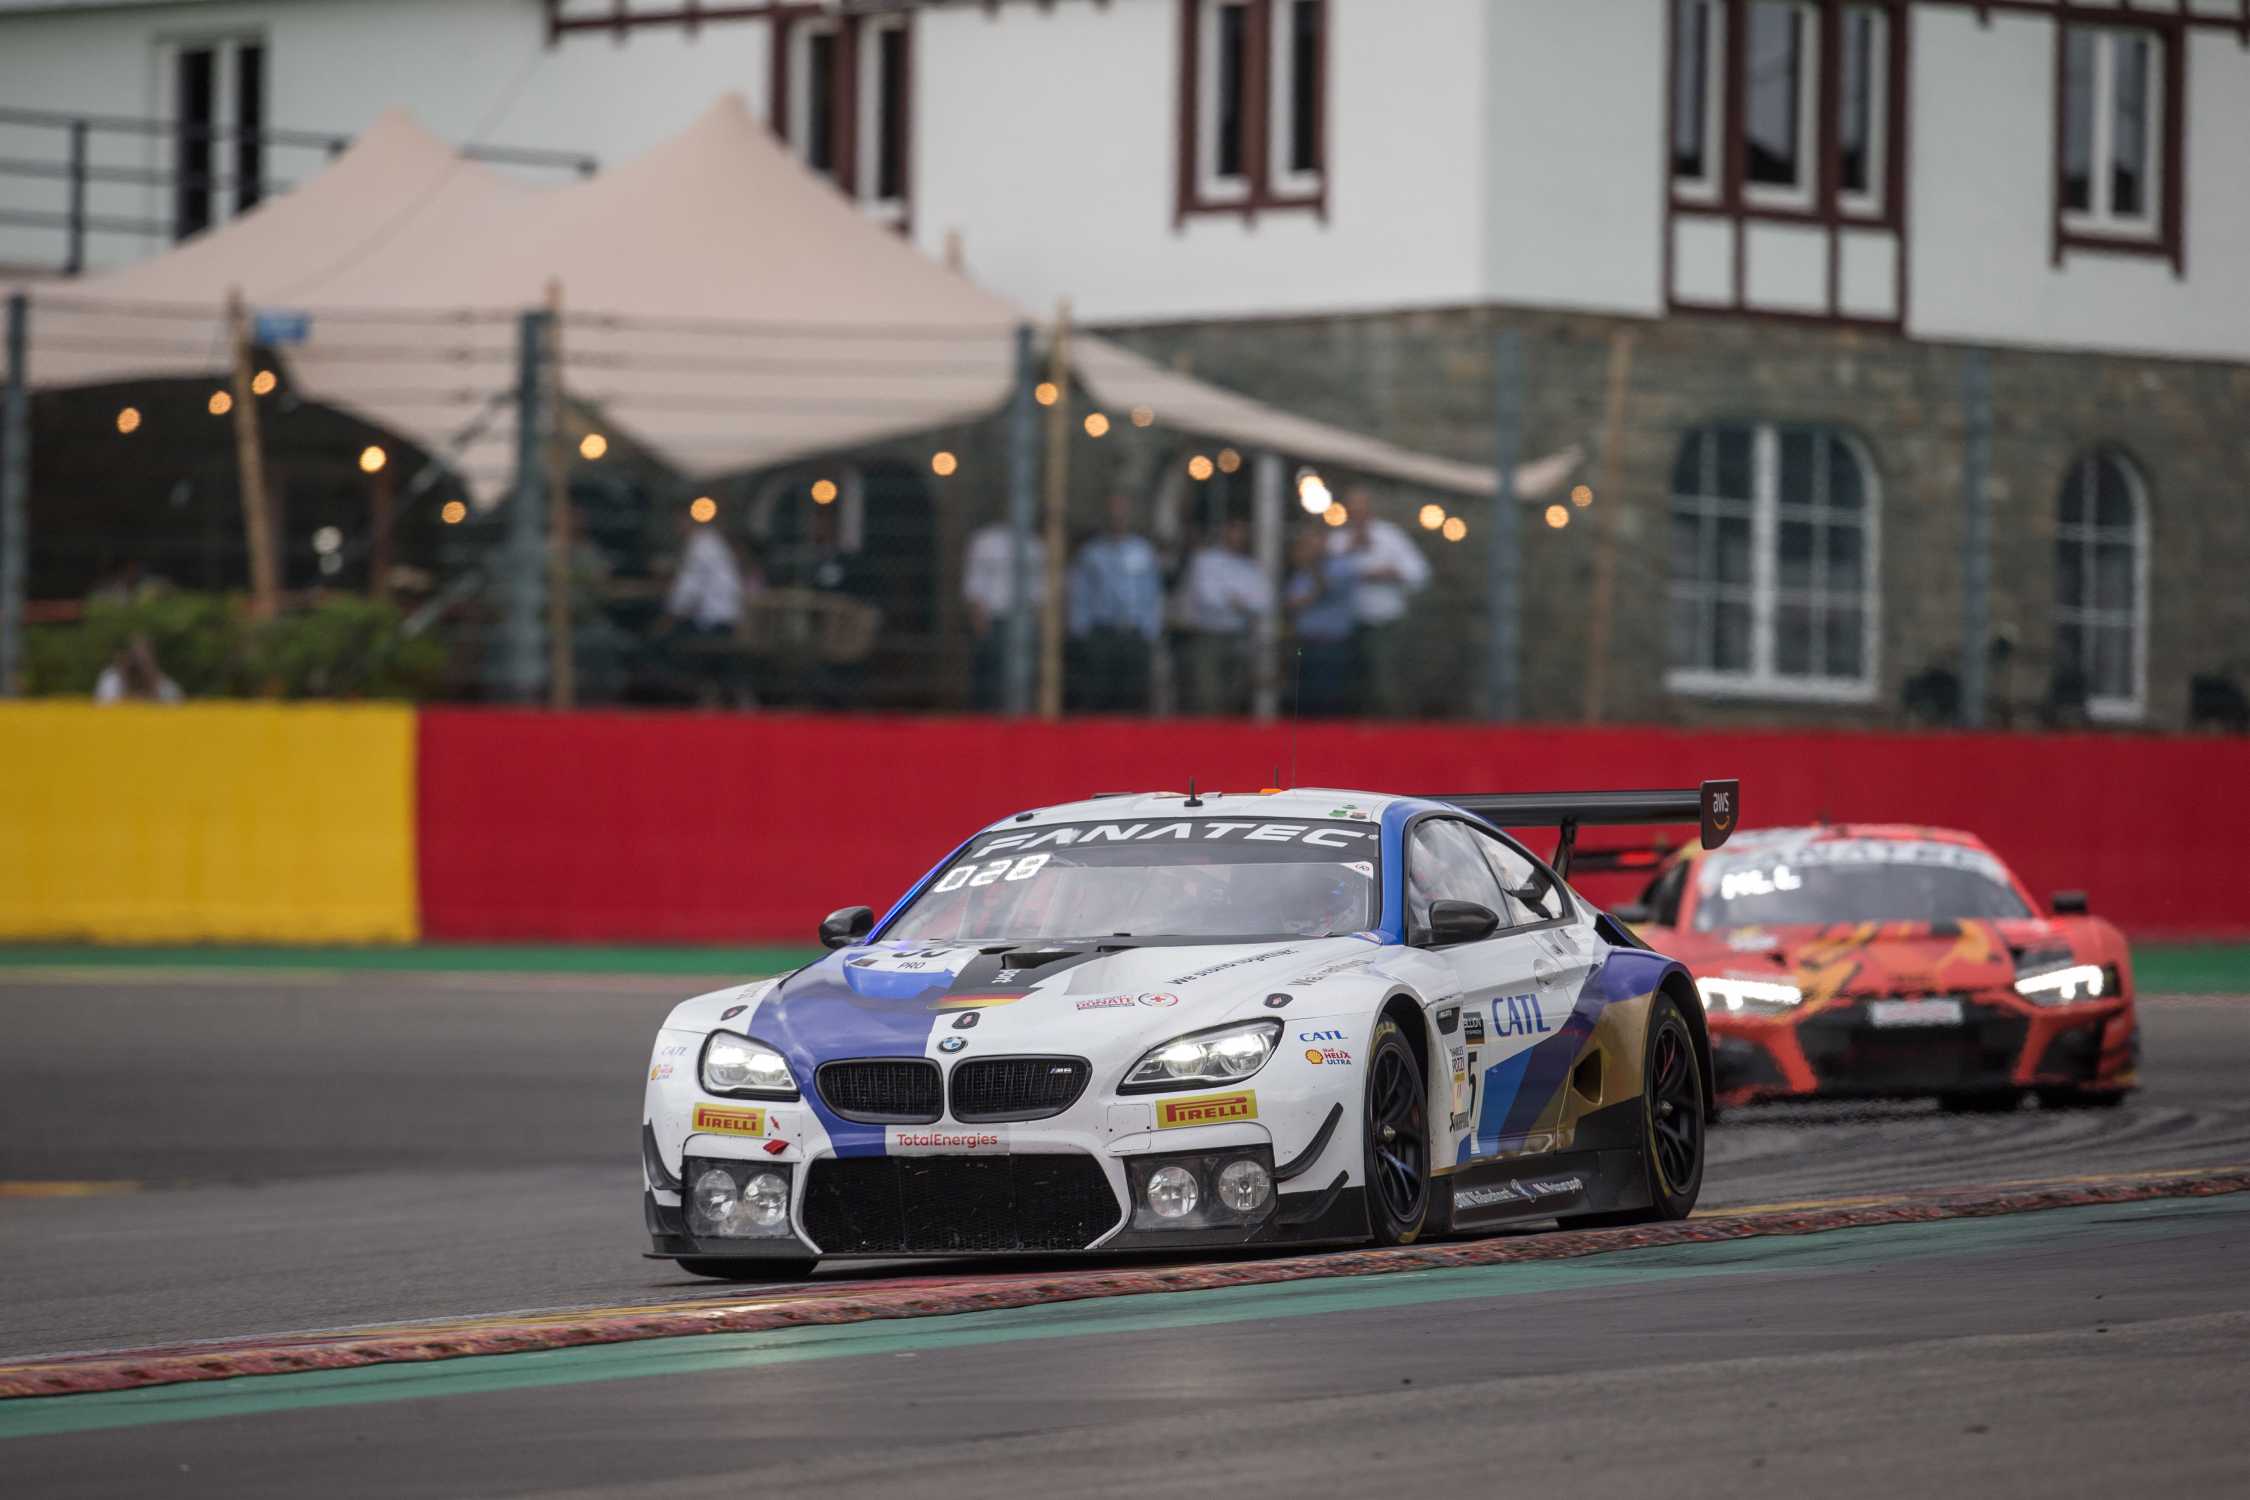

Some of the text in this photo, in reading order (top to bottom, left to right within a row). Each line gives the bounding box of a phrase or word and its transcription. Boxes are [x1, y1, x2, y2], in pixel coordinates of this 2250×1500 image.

[1713, 792, 1729, 814] aws
[972, 822, 1366, 859] FANATEC
[933, 853, 1051, 893] 028
[897, 961, 926, 970] PRO
[1491, 993, 1552, 1038] CATL
[1299, 1029, 1349, 1042] CATL
[1323, 1050, 1352, 1060] HELIX
[1326, 1058, 1352, 1066] ULTRA
[698, 1108, 758, 1132] PIRELLI
[1166, 1096, 1248, 1123] PIRELLI
[896, 1132, 998, 1149] TotalEnergies
